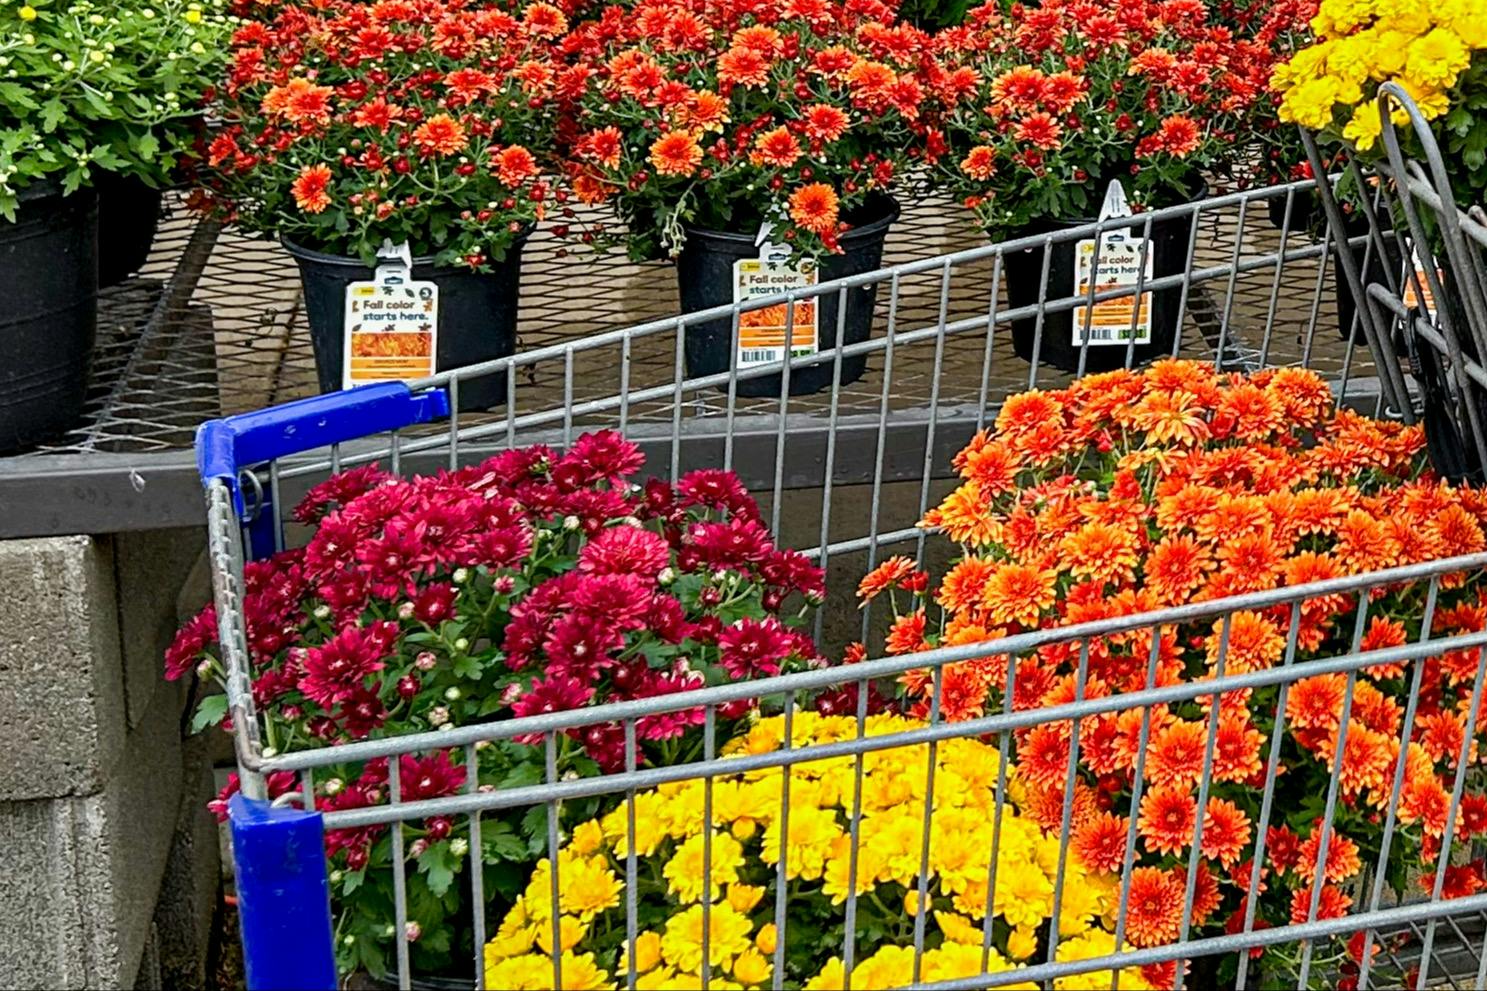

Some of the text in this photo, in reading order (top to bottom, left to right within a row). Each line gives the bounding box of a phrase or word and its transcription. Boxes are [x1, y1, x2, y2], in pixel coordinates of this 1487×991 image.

[1109, 255, 1134, 264] color
[750, 274, 797, 284] Fall color
[749, 286, 782, 295] starts
[363, 300, 416, 310] Fall color
[363, 312, 397, 321] starts
